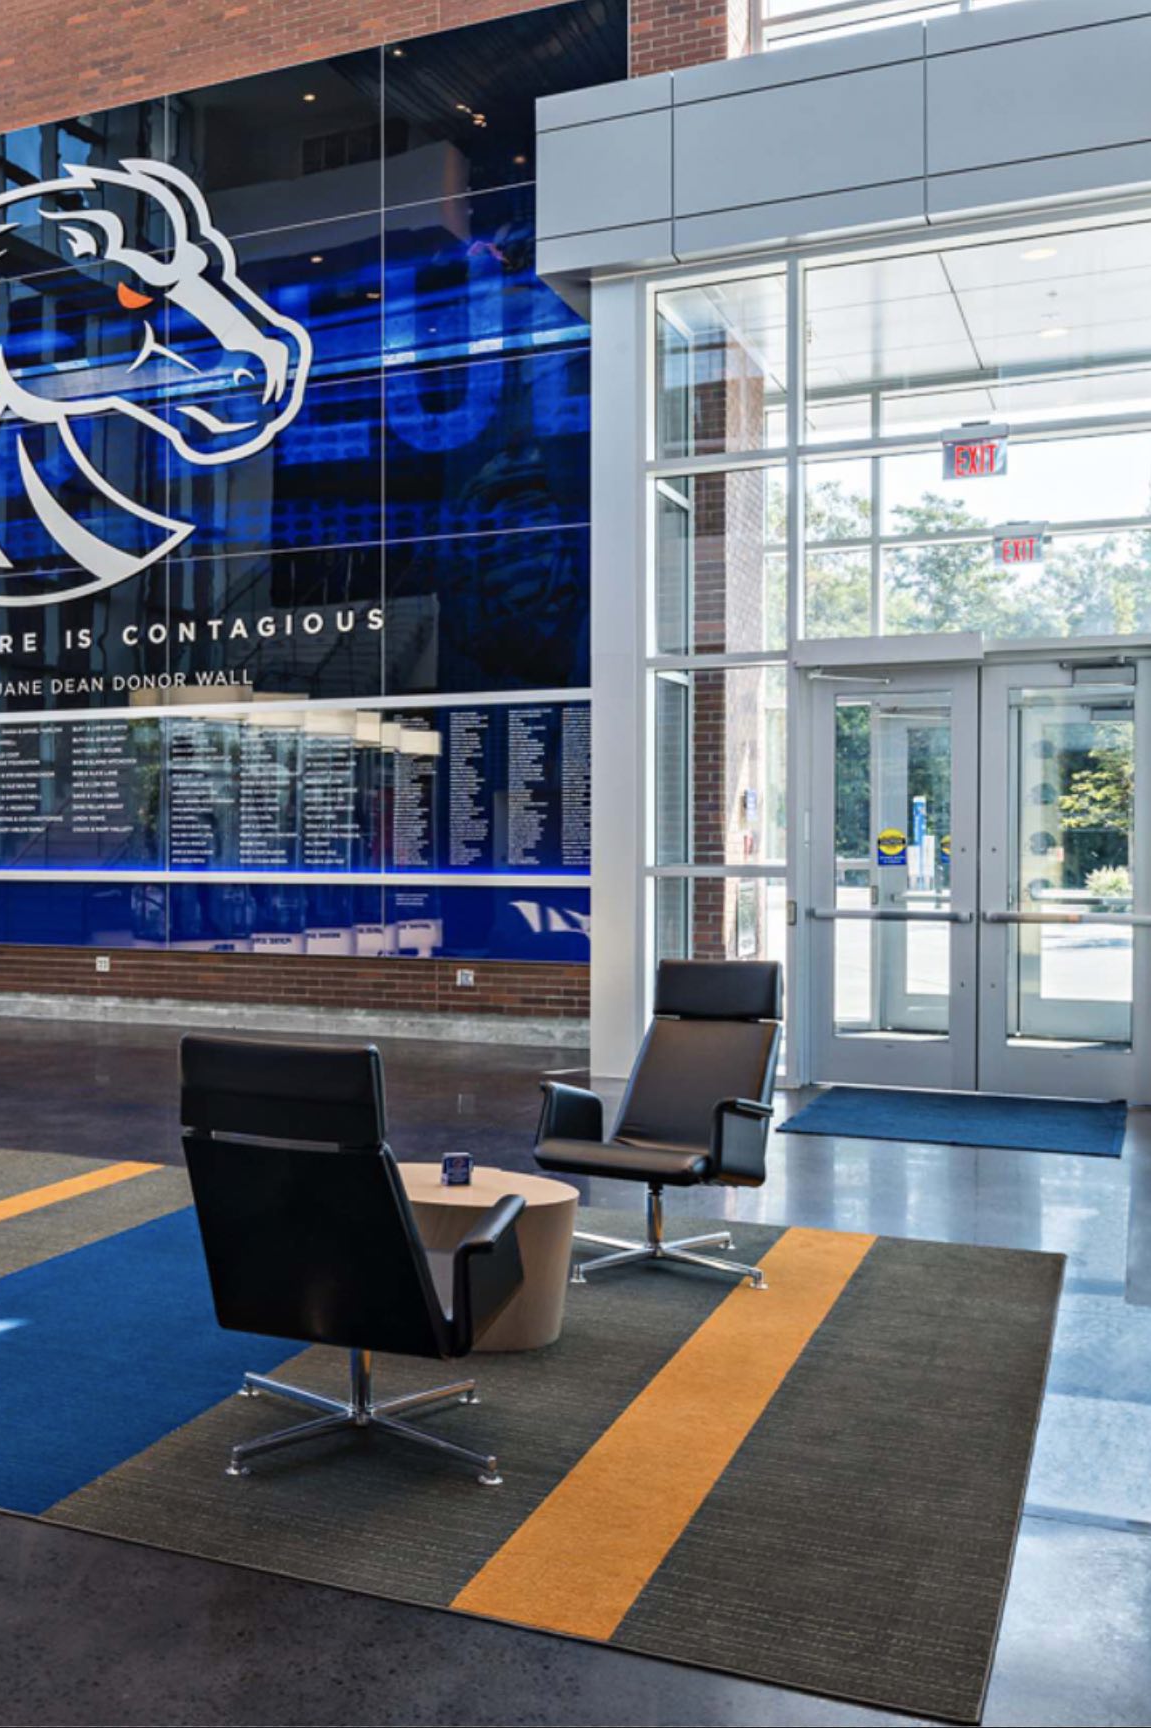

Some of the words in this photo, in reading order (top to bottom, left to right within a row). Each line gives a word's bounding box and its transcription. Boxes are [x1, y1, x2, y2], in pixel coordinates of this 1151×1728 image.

[955, 444, 998, 477] EXIT
[1002, 537, 1036, 563] EXIT
[65, 629, 93, 650] IS
[122, 609, 385, 646] CONTAGIOUS
[51, 677, 104, 695] DEAN
[112, 672, 187, 692] DONOR
[195, 669, 253, 687] WALL
